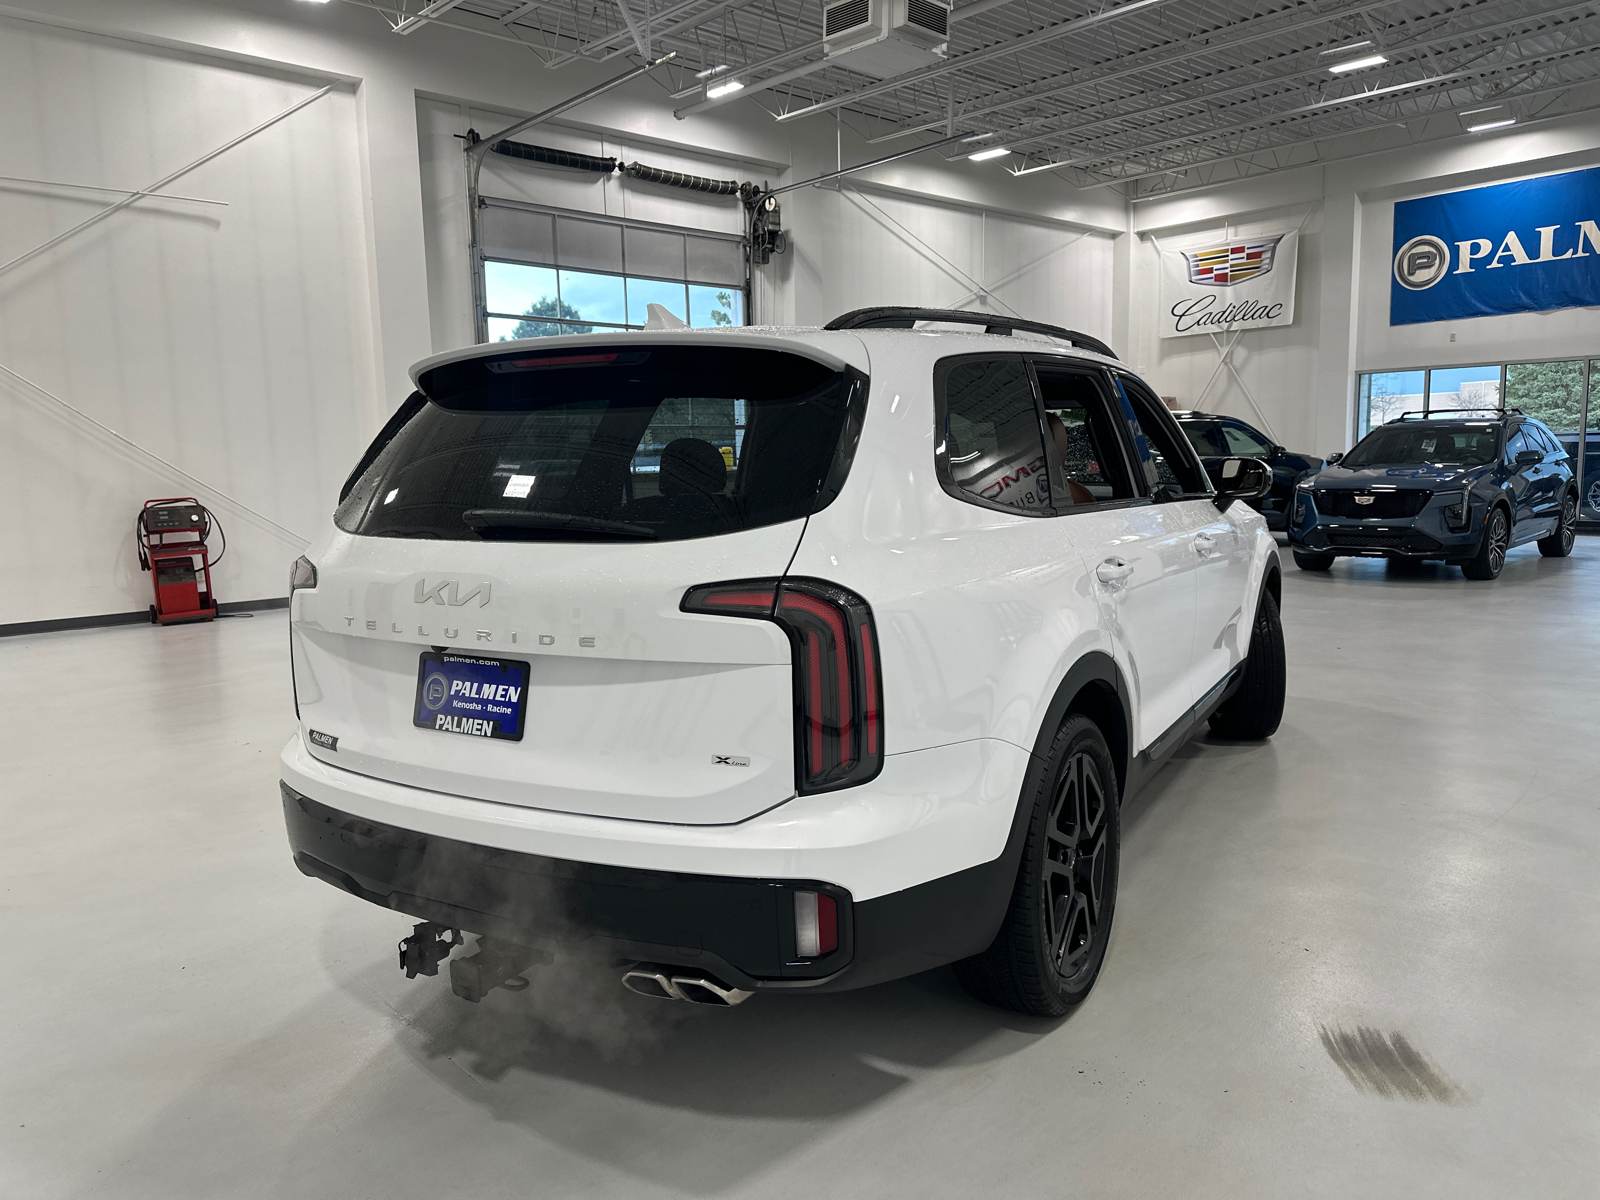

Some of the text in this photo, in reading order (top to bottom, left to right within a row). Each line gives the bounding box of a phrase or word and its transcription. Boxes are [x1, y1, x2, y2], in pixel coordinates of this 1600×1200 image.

[1171, 294, 1283, 332] Cadillac
[414, 578, 492, 608] KIA
[344, 615, 596, 648] TELLURIDE
[443, 655, 500, 667] palmen.com
[450, 680, 521, 703] PALMEN
[452, 699, 482, 711] Kenosha
[487, 704, 512, 714] Racine
[435, 714, 493, 737] PALMEN
[313, 731, 334, 744] PALMEN
